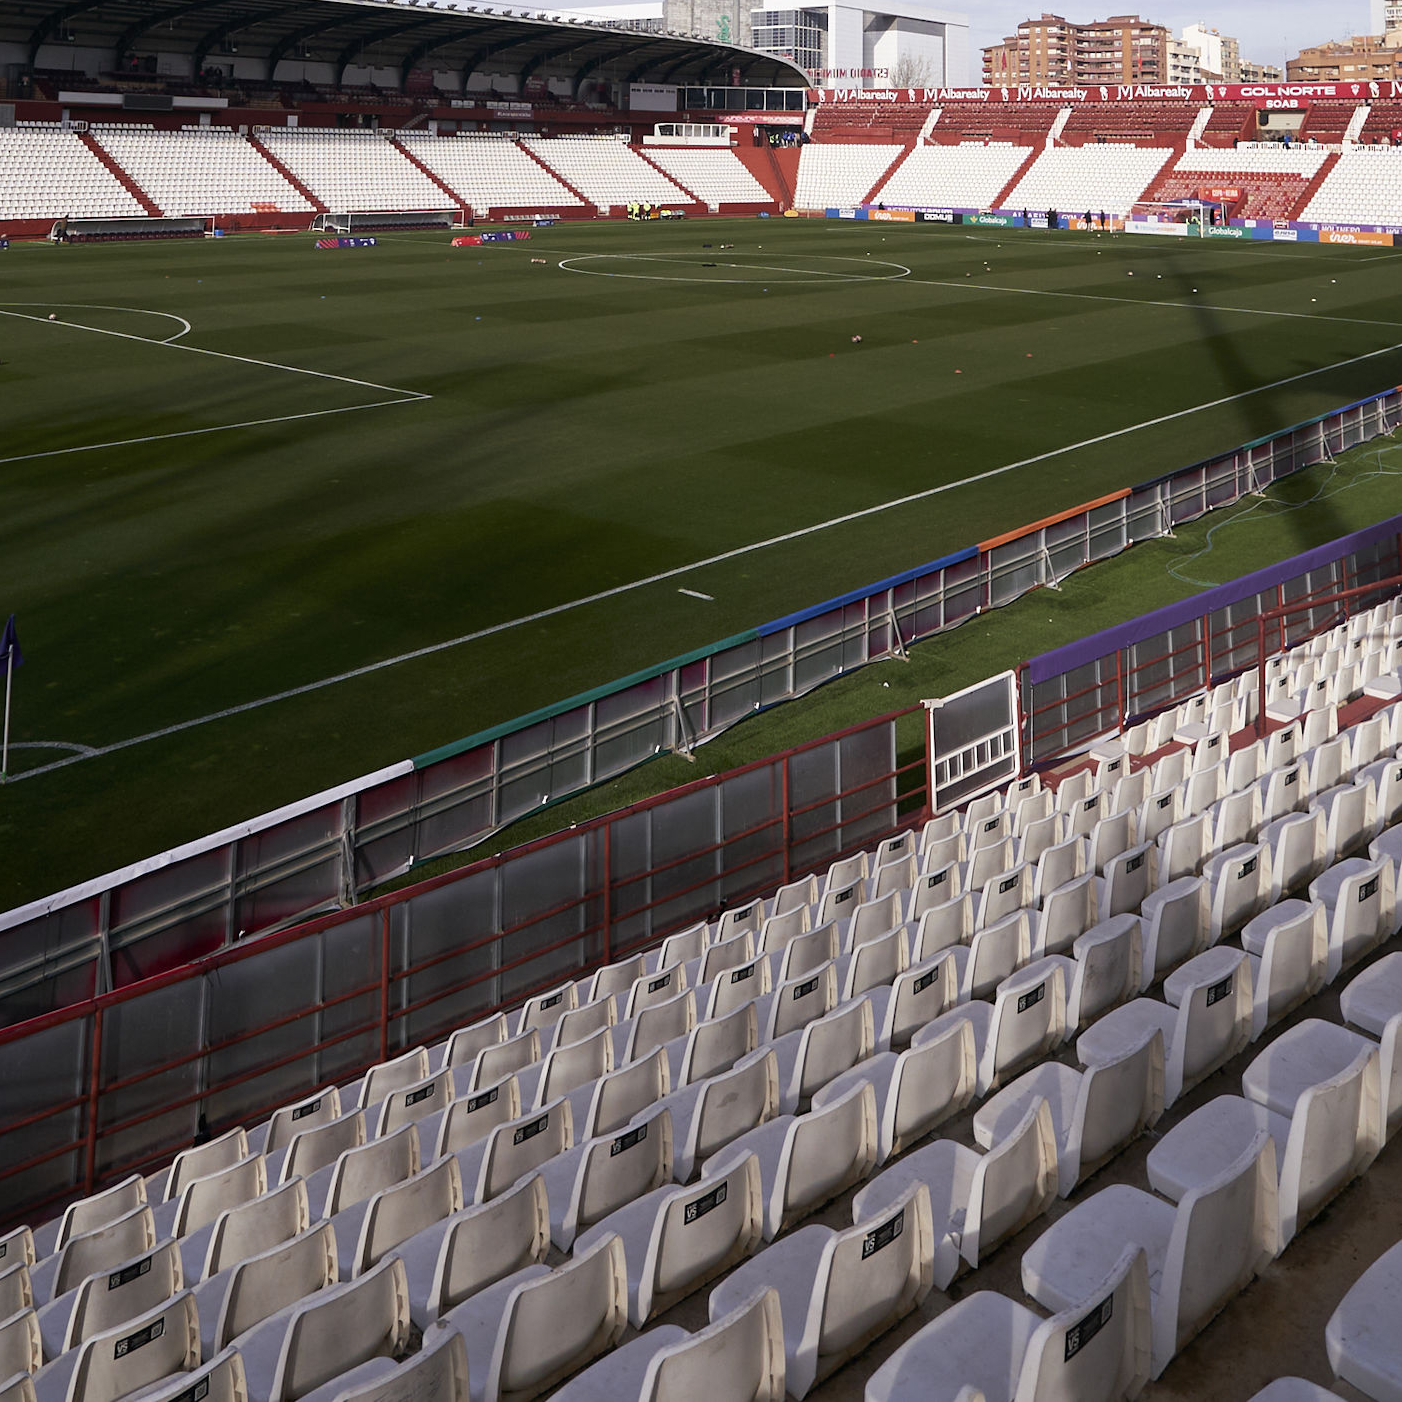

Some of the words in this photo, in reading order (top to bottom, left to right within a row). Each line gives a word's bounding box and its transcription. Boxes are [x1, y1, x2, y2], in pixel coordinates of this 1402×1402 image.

[849, 89, 898, 102] Albarealty
[939, 88, 990, 100] Albarealty
[1034, 86, 1087, 100] Albarealty
[1135, 85, 1192, 99] Albarealty
[1241, 87, 1276, 97] GOL
[1278, 85, 1337, 96] NORTE
[1266, 99, 1298, 109] SOAB
[1208, 226, 1243, 238] Globalcaja
[687, 1207, 697, 1218] VS
